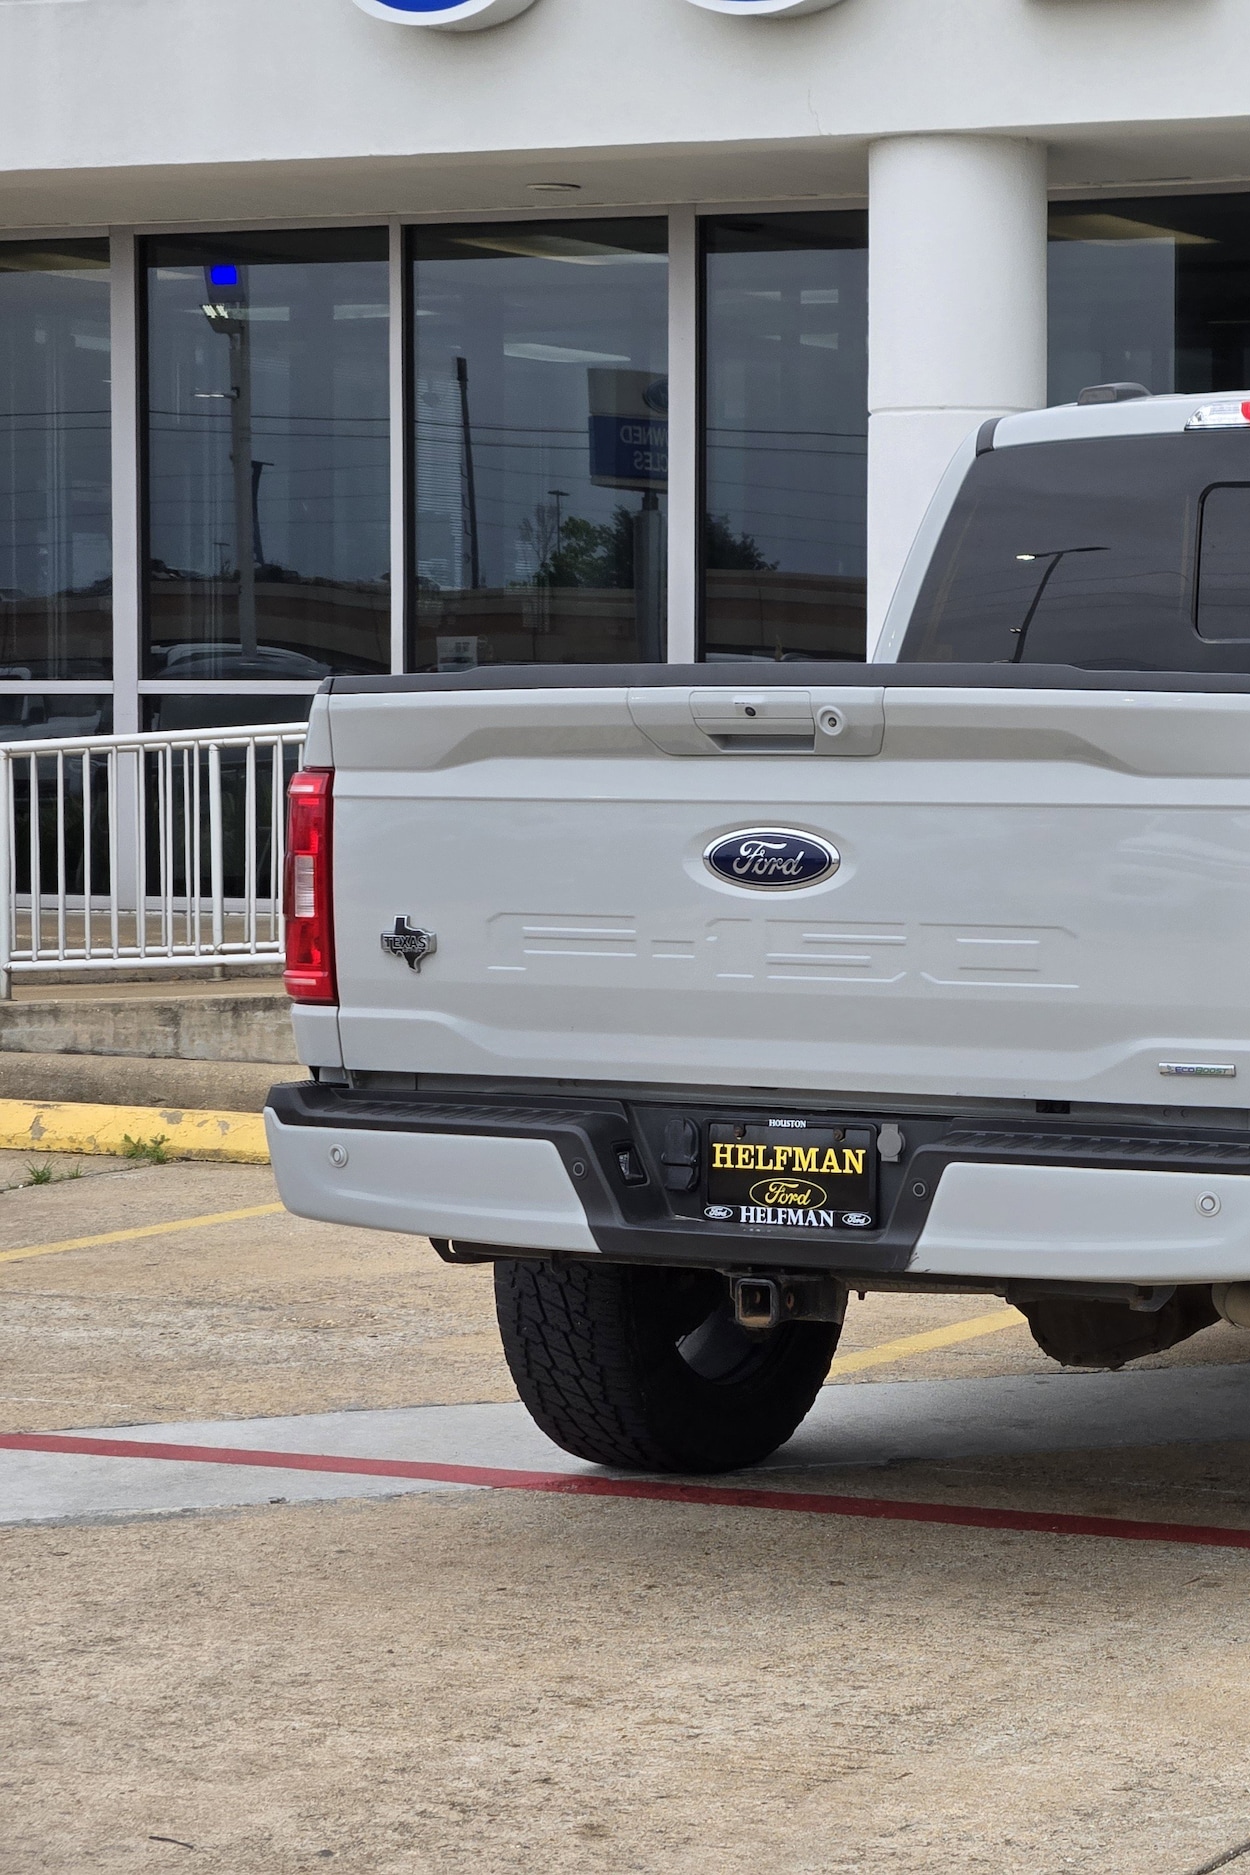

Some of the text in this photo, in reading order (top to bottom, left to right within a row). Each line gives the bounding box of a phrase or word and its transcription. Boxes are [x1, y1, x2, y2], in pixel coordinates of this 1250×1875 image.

[732, 840, 805, 876] Ford
[383, 936, 427, 948] TEXAS
[768, 1119, 807, 1128] HOUSTON
[712, 1143, 866, 1174] HELFMAN
[764, 1181, 812, 1206] Ford
[739, 1206, 834, 1227] HELFMAN
